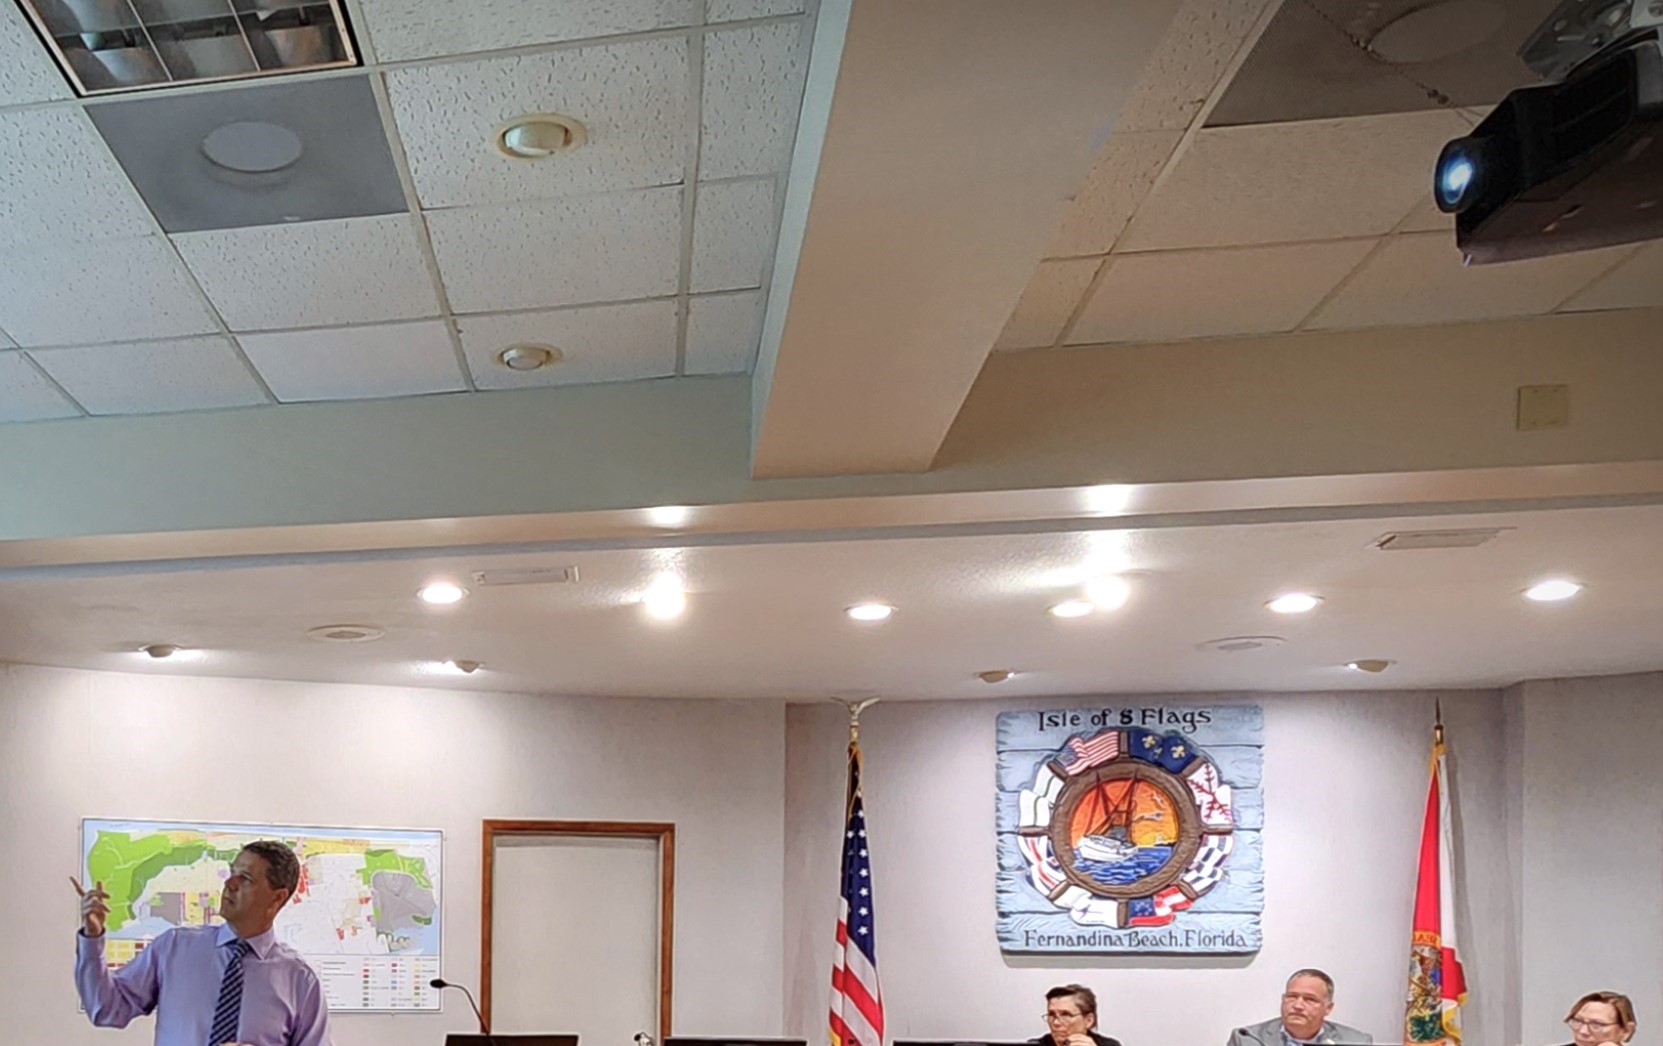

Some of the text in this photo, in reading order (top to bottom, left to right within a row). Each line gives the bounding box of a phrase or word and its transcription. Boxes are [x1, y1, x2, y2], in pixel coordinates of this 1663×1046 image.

[1038, 707, 1212, 734] Isle of 8 Flags
[1024, 930, 1124, 948] Fernandina
[1184, 930, 1247, 948] Florida
